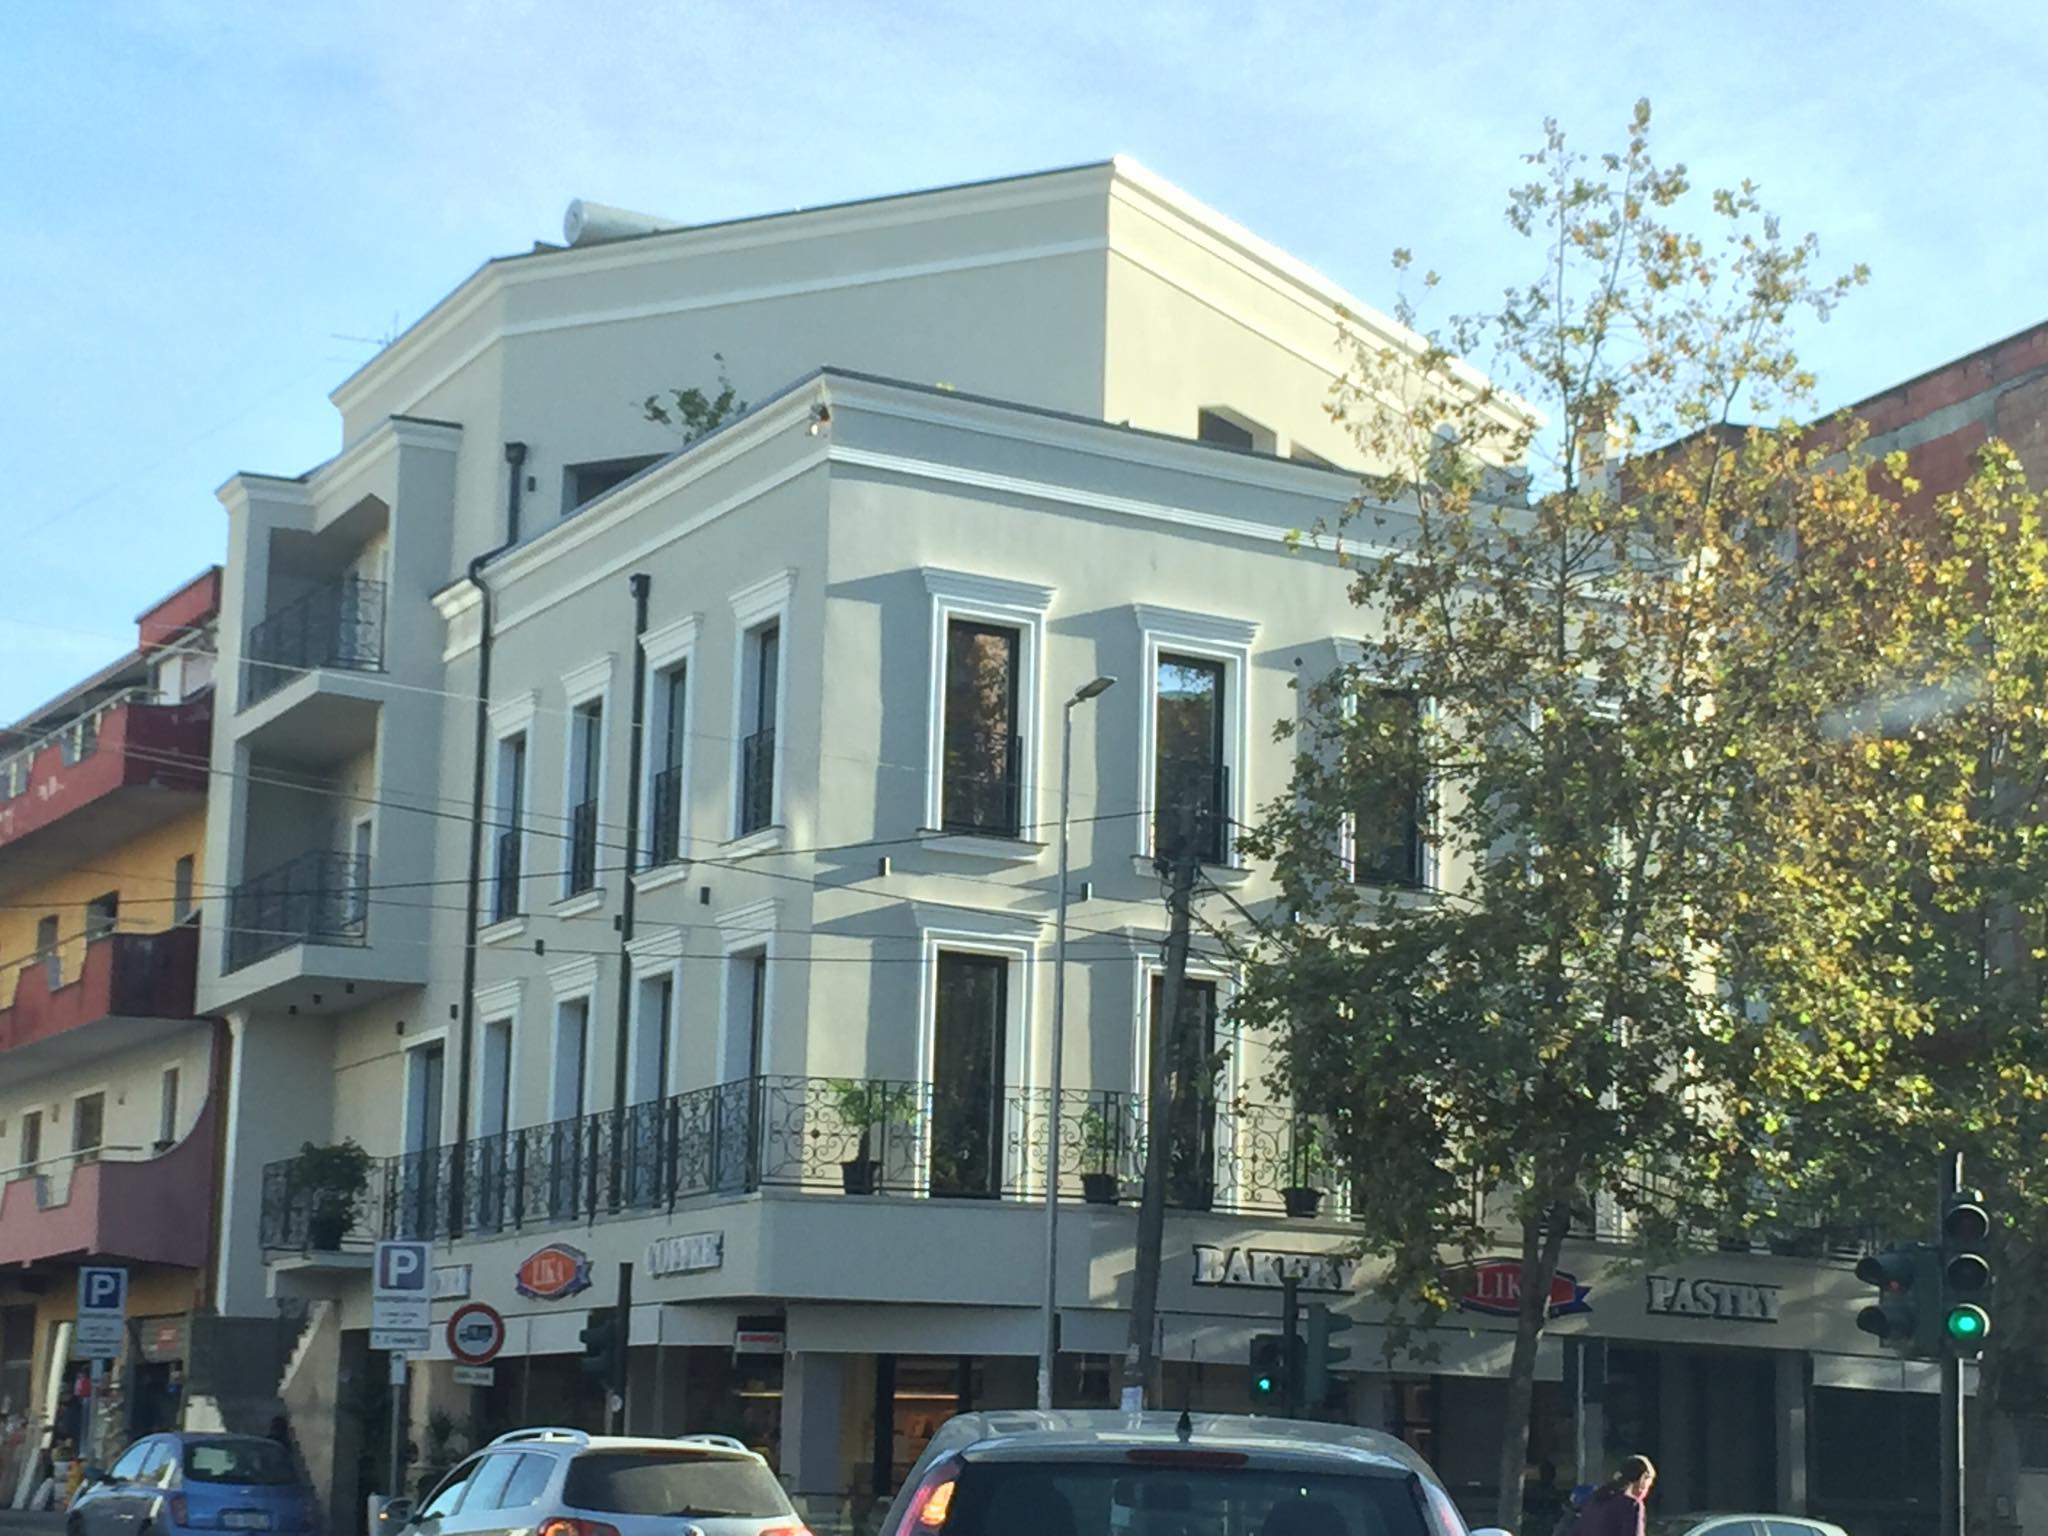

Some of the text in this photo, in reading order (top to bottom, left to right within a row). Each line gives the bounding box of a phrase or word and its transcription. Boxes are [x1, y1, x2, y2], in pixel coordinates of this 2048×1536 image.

[388, 1249, 418, 1287] P
[1475, 1271, 1521, 1299] LIK
[90, 1273, 116, 1305] P
[1648, 1277, 1783, 1320] PASTRY
